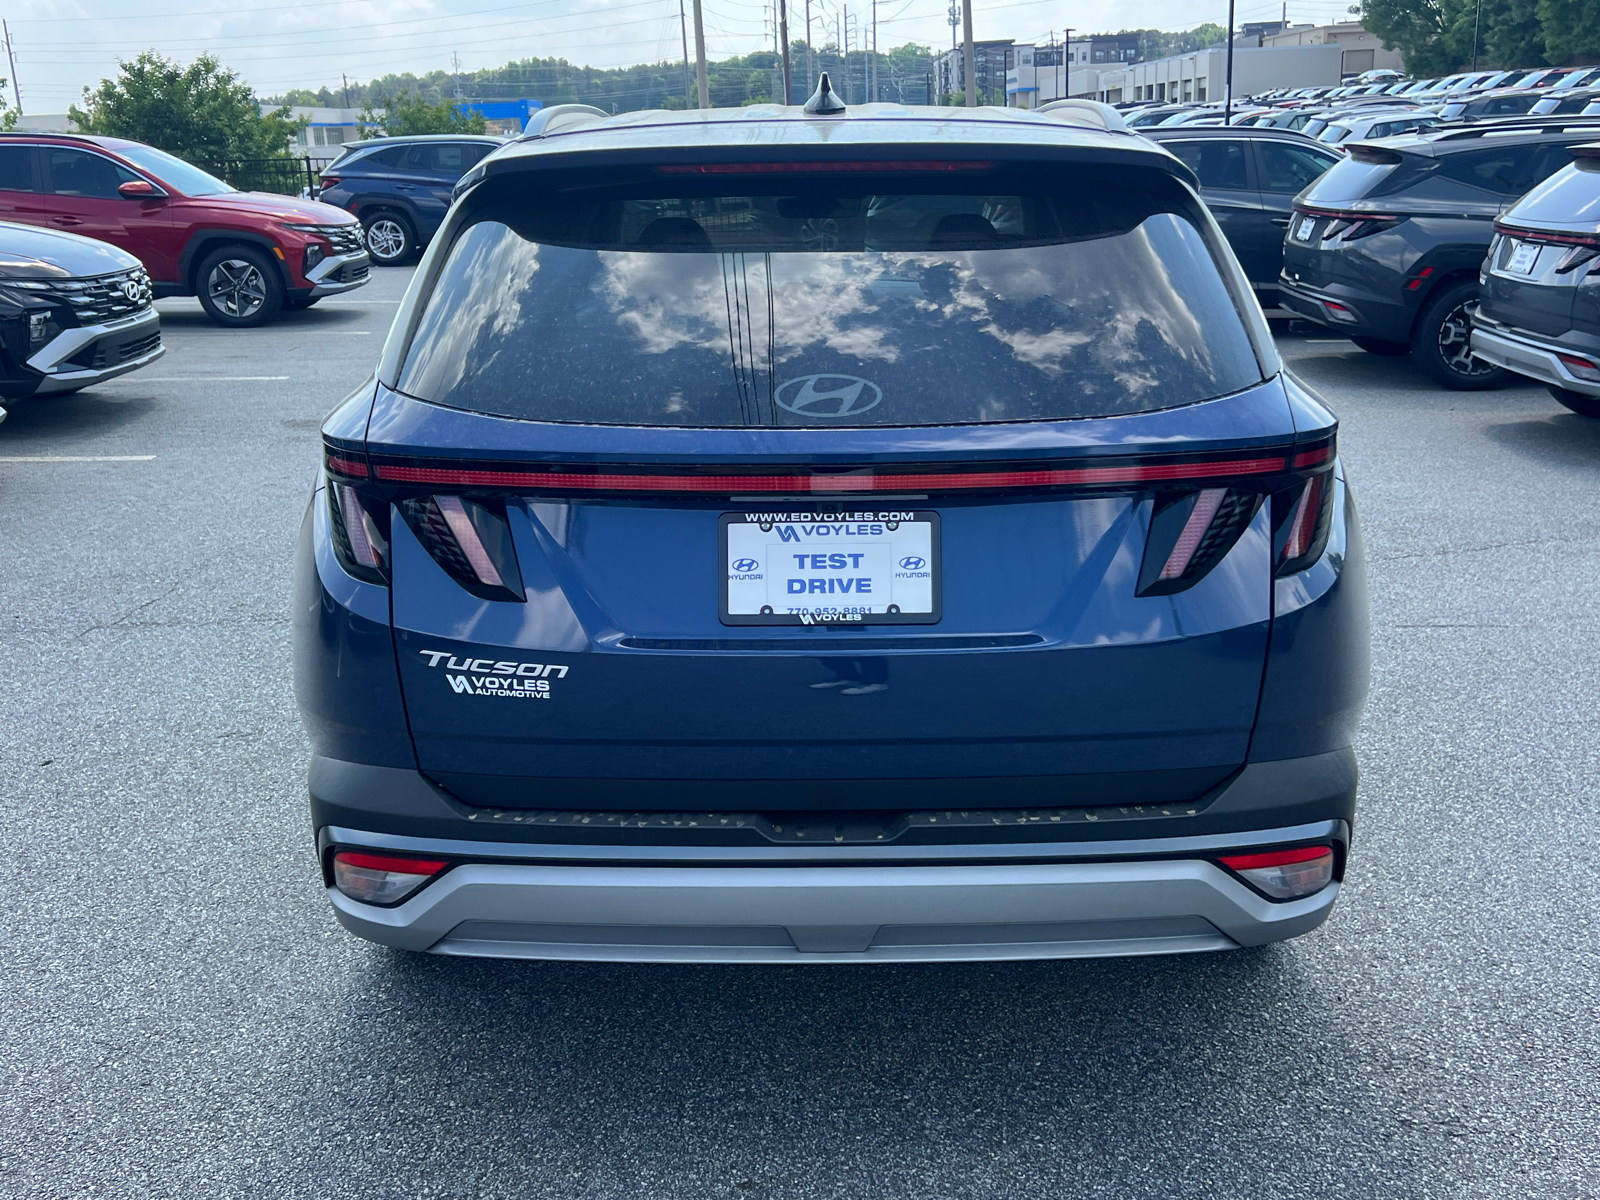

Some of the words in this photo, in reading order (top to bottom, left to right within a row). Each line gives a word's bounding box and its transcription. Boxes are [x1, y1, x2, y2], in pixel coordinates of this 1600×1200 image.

[801, 524, 883, 536] VOYLES
[793, 553, 864, 570] TEST
[787, 577, 872, 594] DRIVE
[471, 676, 550, 691] VOYLES
[475, 688, 550, 699] AUTOMOTIVE
